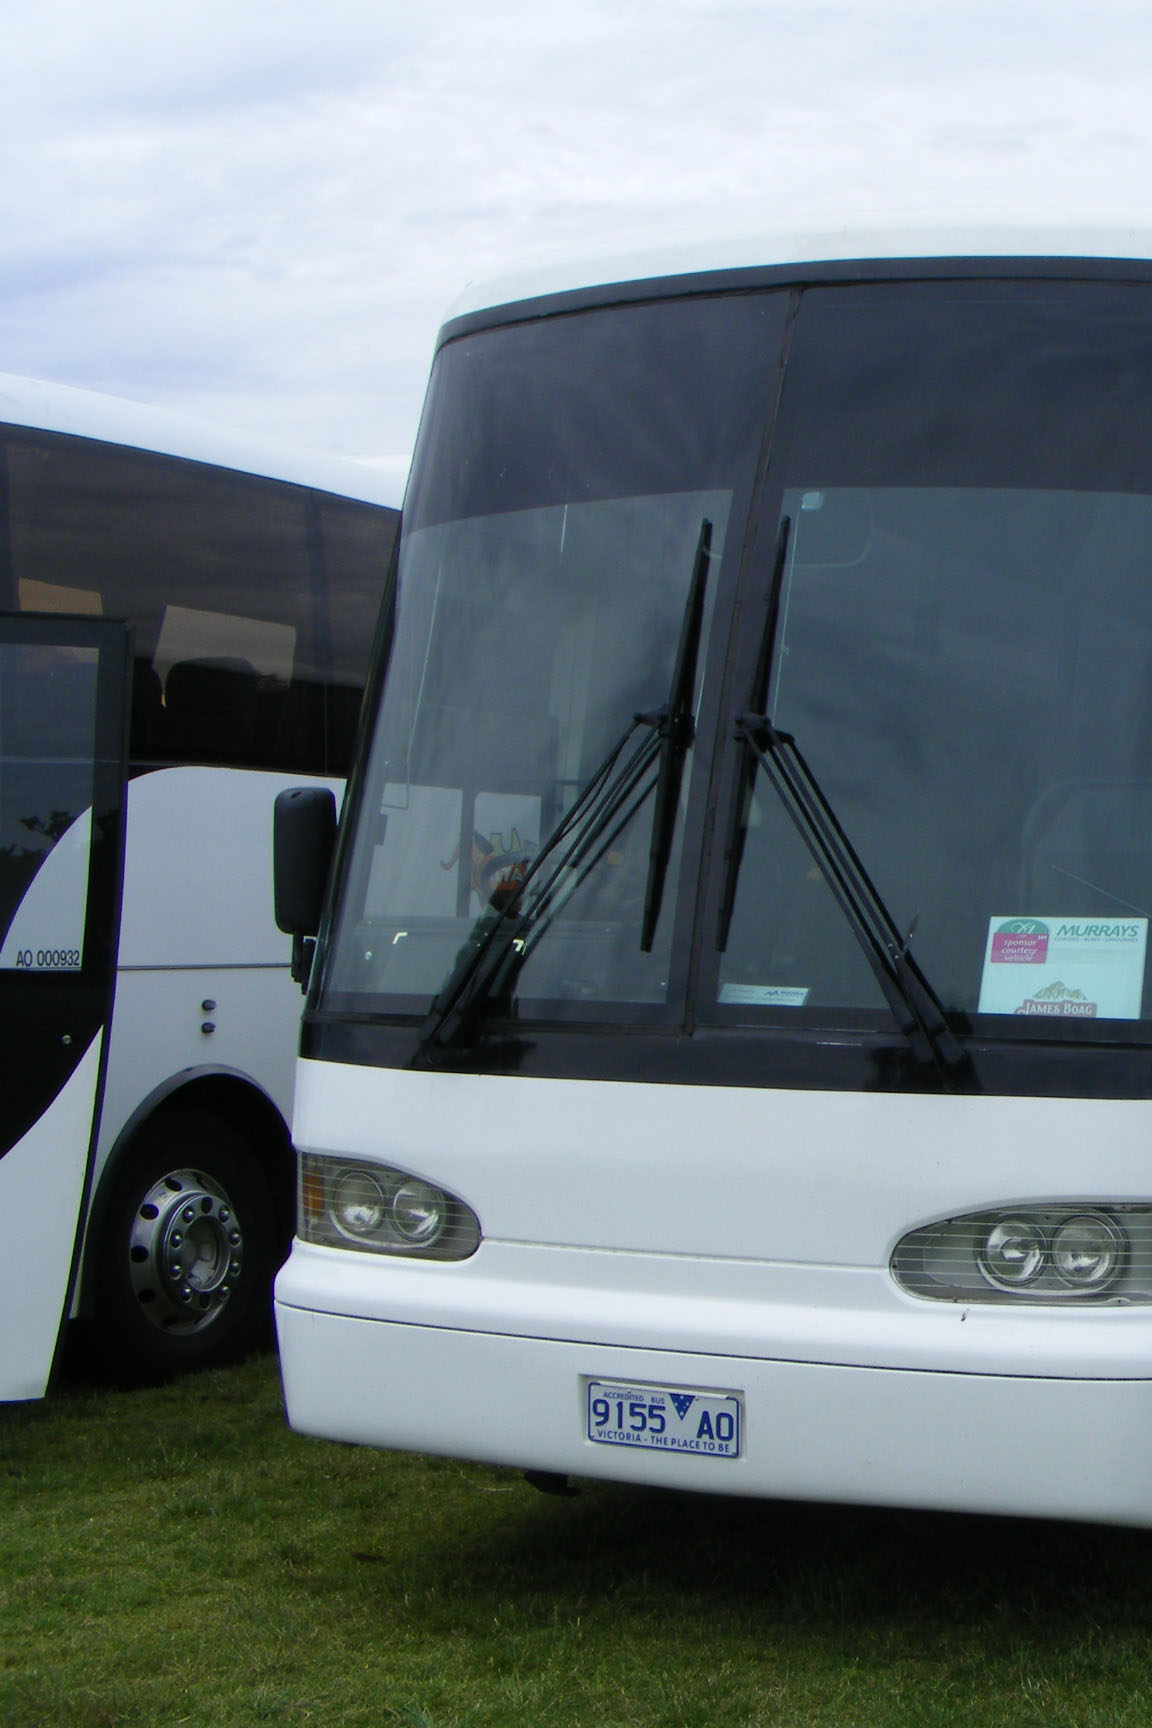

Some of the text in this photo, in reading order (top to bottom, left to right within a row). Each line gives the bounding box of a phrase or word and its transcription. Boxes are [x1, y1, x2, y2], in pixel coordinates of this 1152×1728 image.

[1056, 924, 1140, 937] MURRAYS
[1004, 940, 1037, 948] sponsor
[16, 950, 80, 966] AO 000932
[1001, 947, 1038, 956] courtesy
[1003, 954, 1033, 962] vehicle
[1026, 1002, 1093, 1015] JAMES BOAG
[603, 1391, 665, 1405] ACCREDITED BUS
[592, 1399, 734, 1441] 9155 AO
[597, 1429, 641, 1443] VICTORIA
[650, 1435, 668, 1446] THE
[671, 1438, 700, 1450] PLACE
[702, 1441, 716, 1452] TO
[718, 1443, 730, 1453] BE
